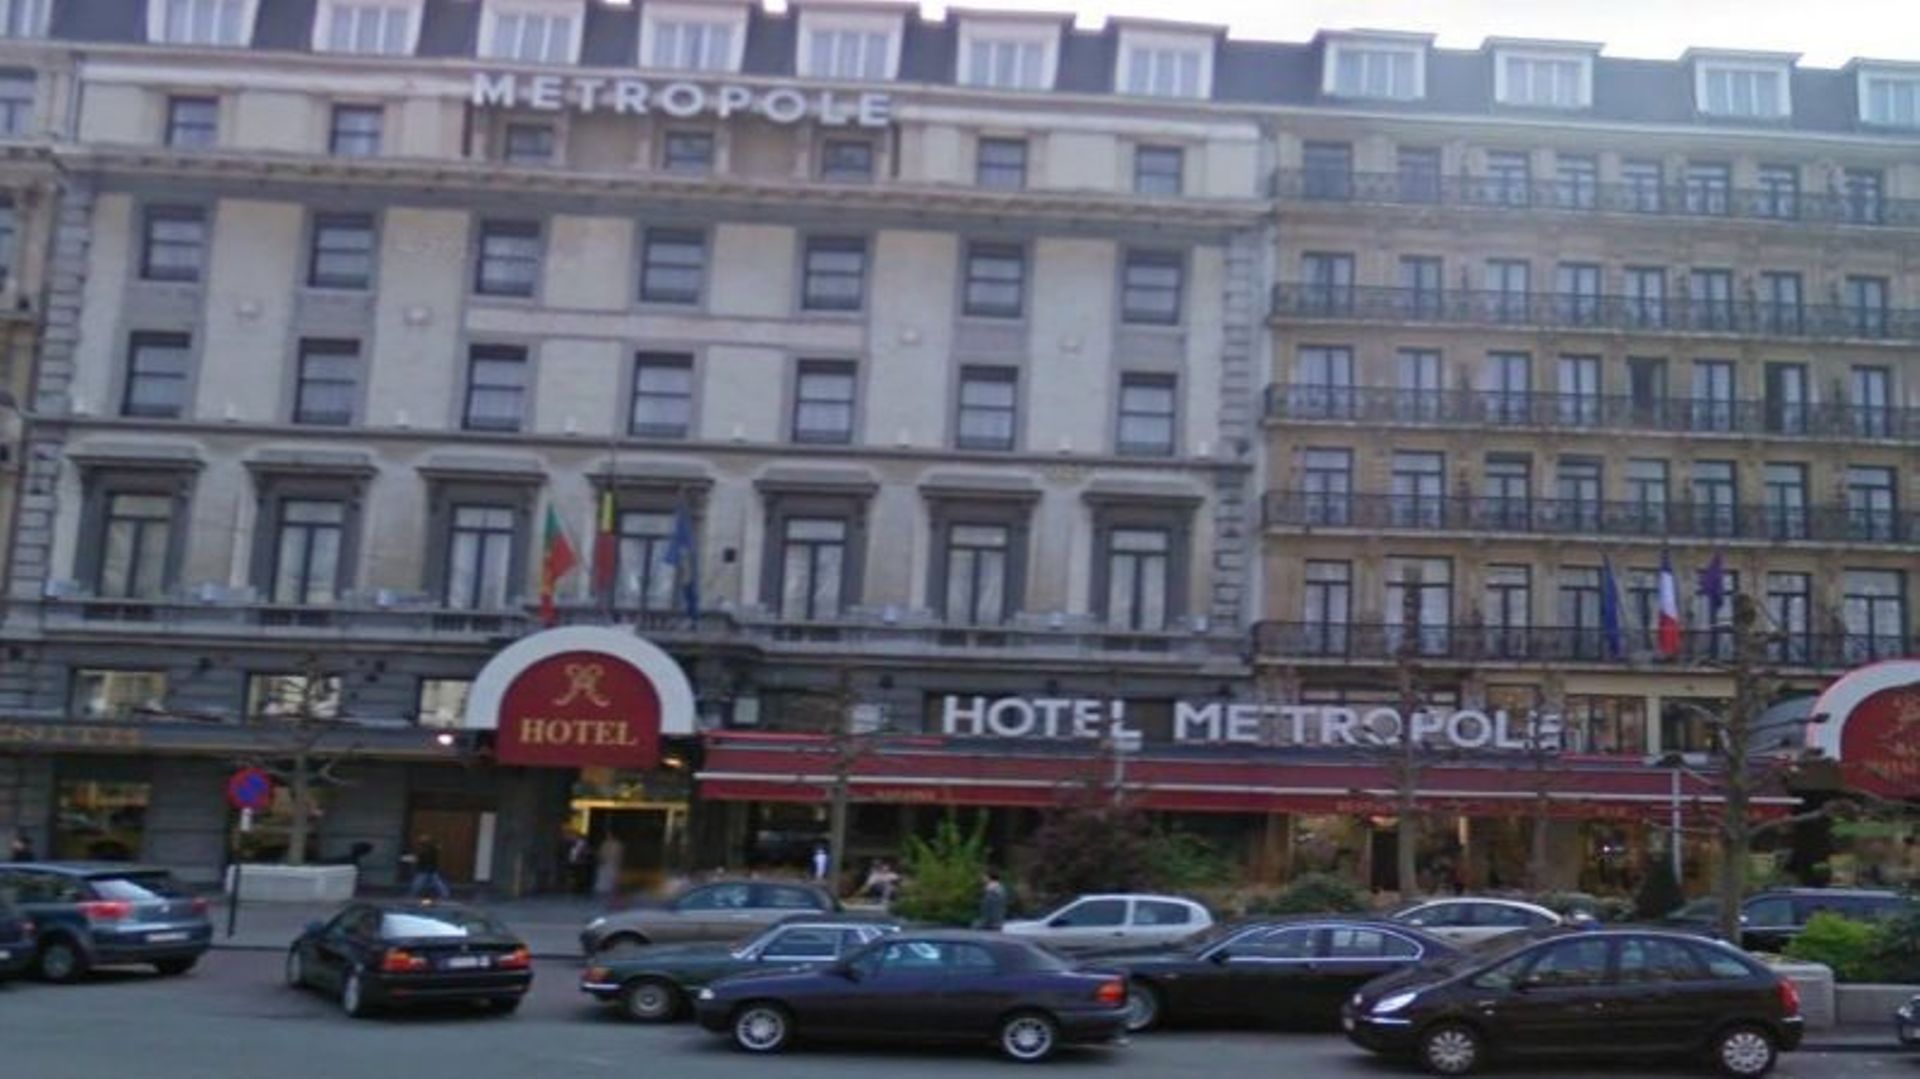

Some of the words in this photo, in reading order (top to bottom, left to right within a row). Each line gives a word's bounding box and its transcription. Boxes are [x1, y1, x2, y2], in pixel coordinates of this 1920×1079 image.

[472, 72, 892, 127] METROPOLE
[518, 717, 639, 747] HOTEL
[943, 695, 1142, 740] HOTEL
[1174, 701, 1562, 751] METROPOLE
